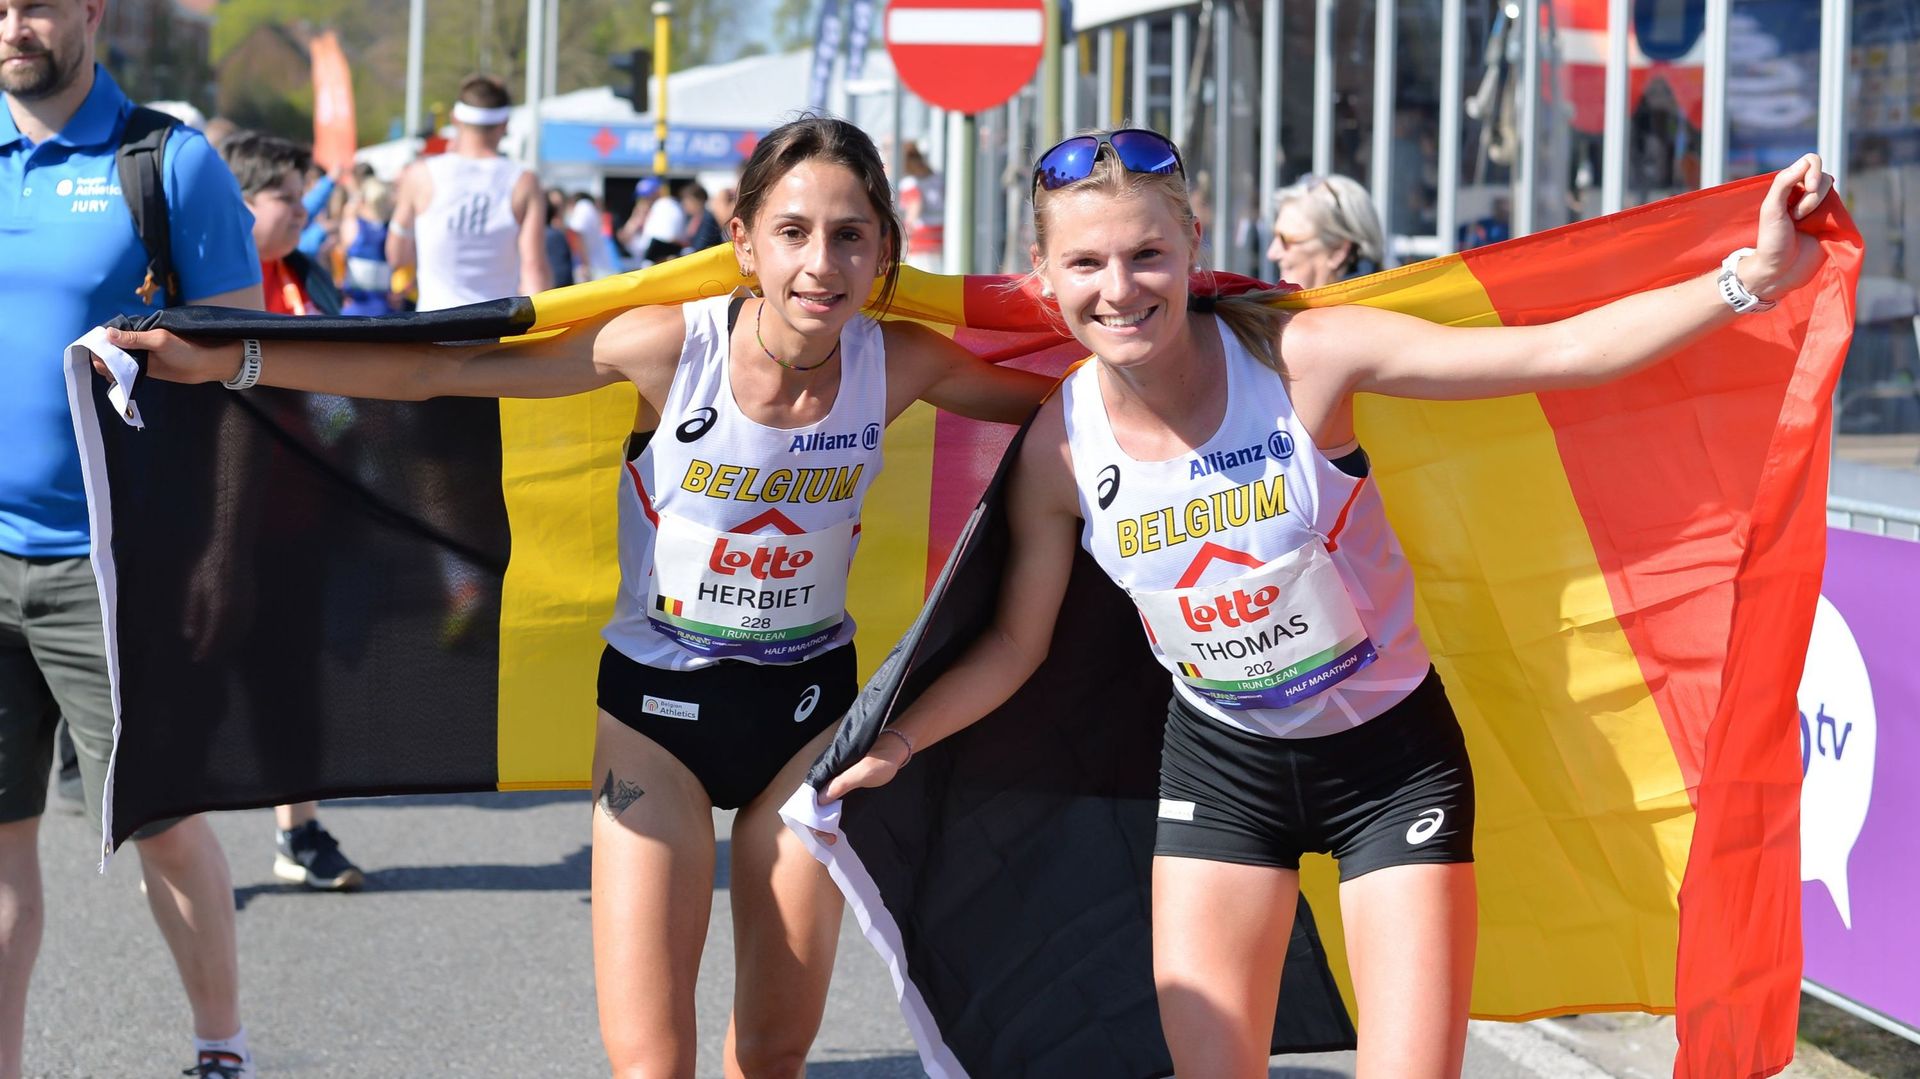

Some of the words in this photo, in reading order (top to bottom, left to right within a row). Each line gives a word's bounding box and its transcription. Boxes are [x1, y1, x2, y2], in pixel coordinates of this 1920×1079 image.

[71, 200, 108, 213] JURY
[789, 431, 857, 452] Allianz
[1189, 444, 1266, 480] Allianz
[680, 459, 864, 503] BELGIUM
[1117, 474, 1290, 558] BELGIUM
[698, 582, 816, 610] HERBIET
[741, 616, 771, 629] 228
[727, 630, 751, 639] RUN
[752, 631, 786, 641] CLEAN
[764, 646, 787, 655] HALF
[787, 634, 829, 653] MARATHON
[1191, 614, 1309, 662] THOMAS
[1242, 681, 1263, 690] RUN
[1264, 667, 1298, 687] CLEAN
[1244, 660, 1275, 677] 202
[1285, 681, 1308, 697] HALF
[1309, 654, 1358, 686] MARATHON
[660, 707, 696, 718] Athletics
